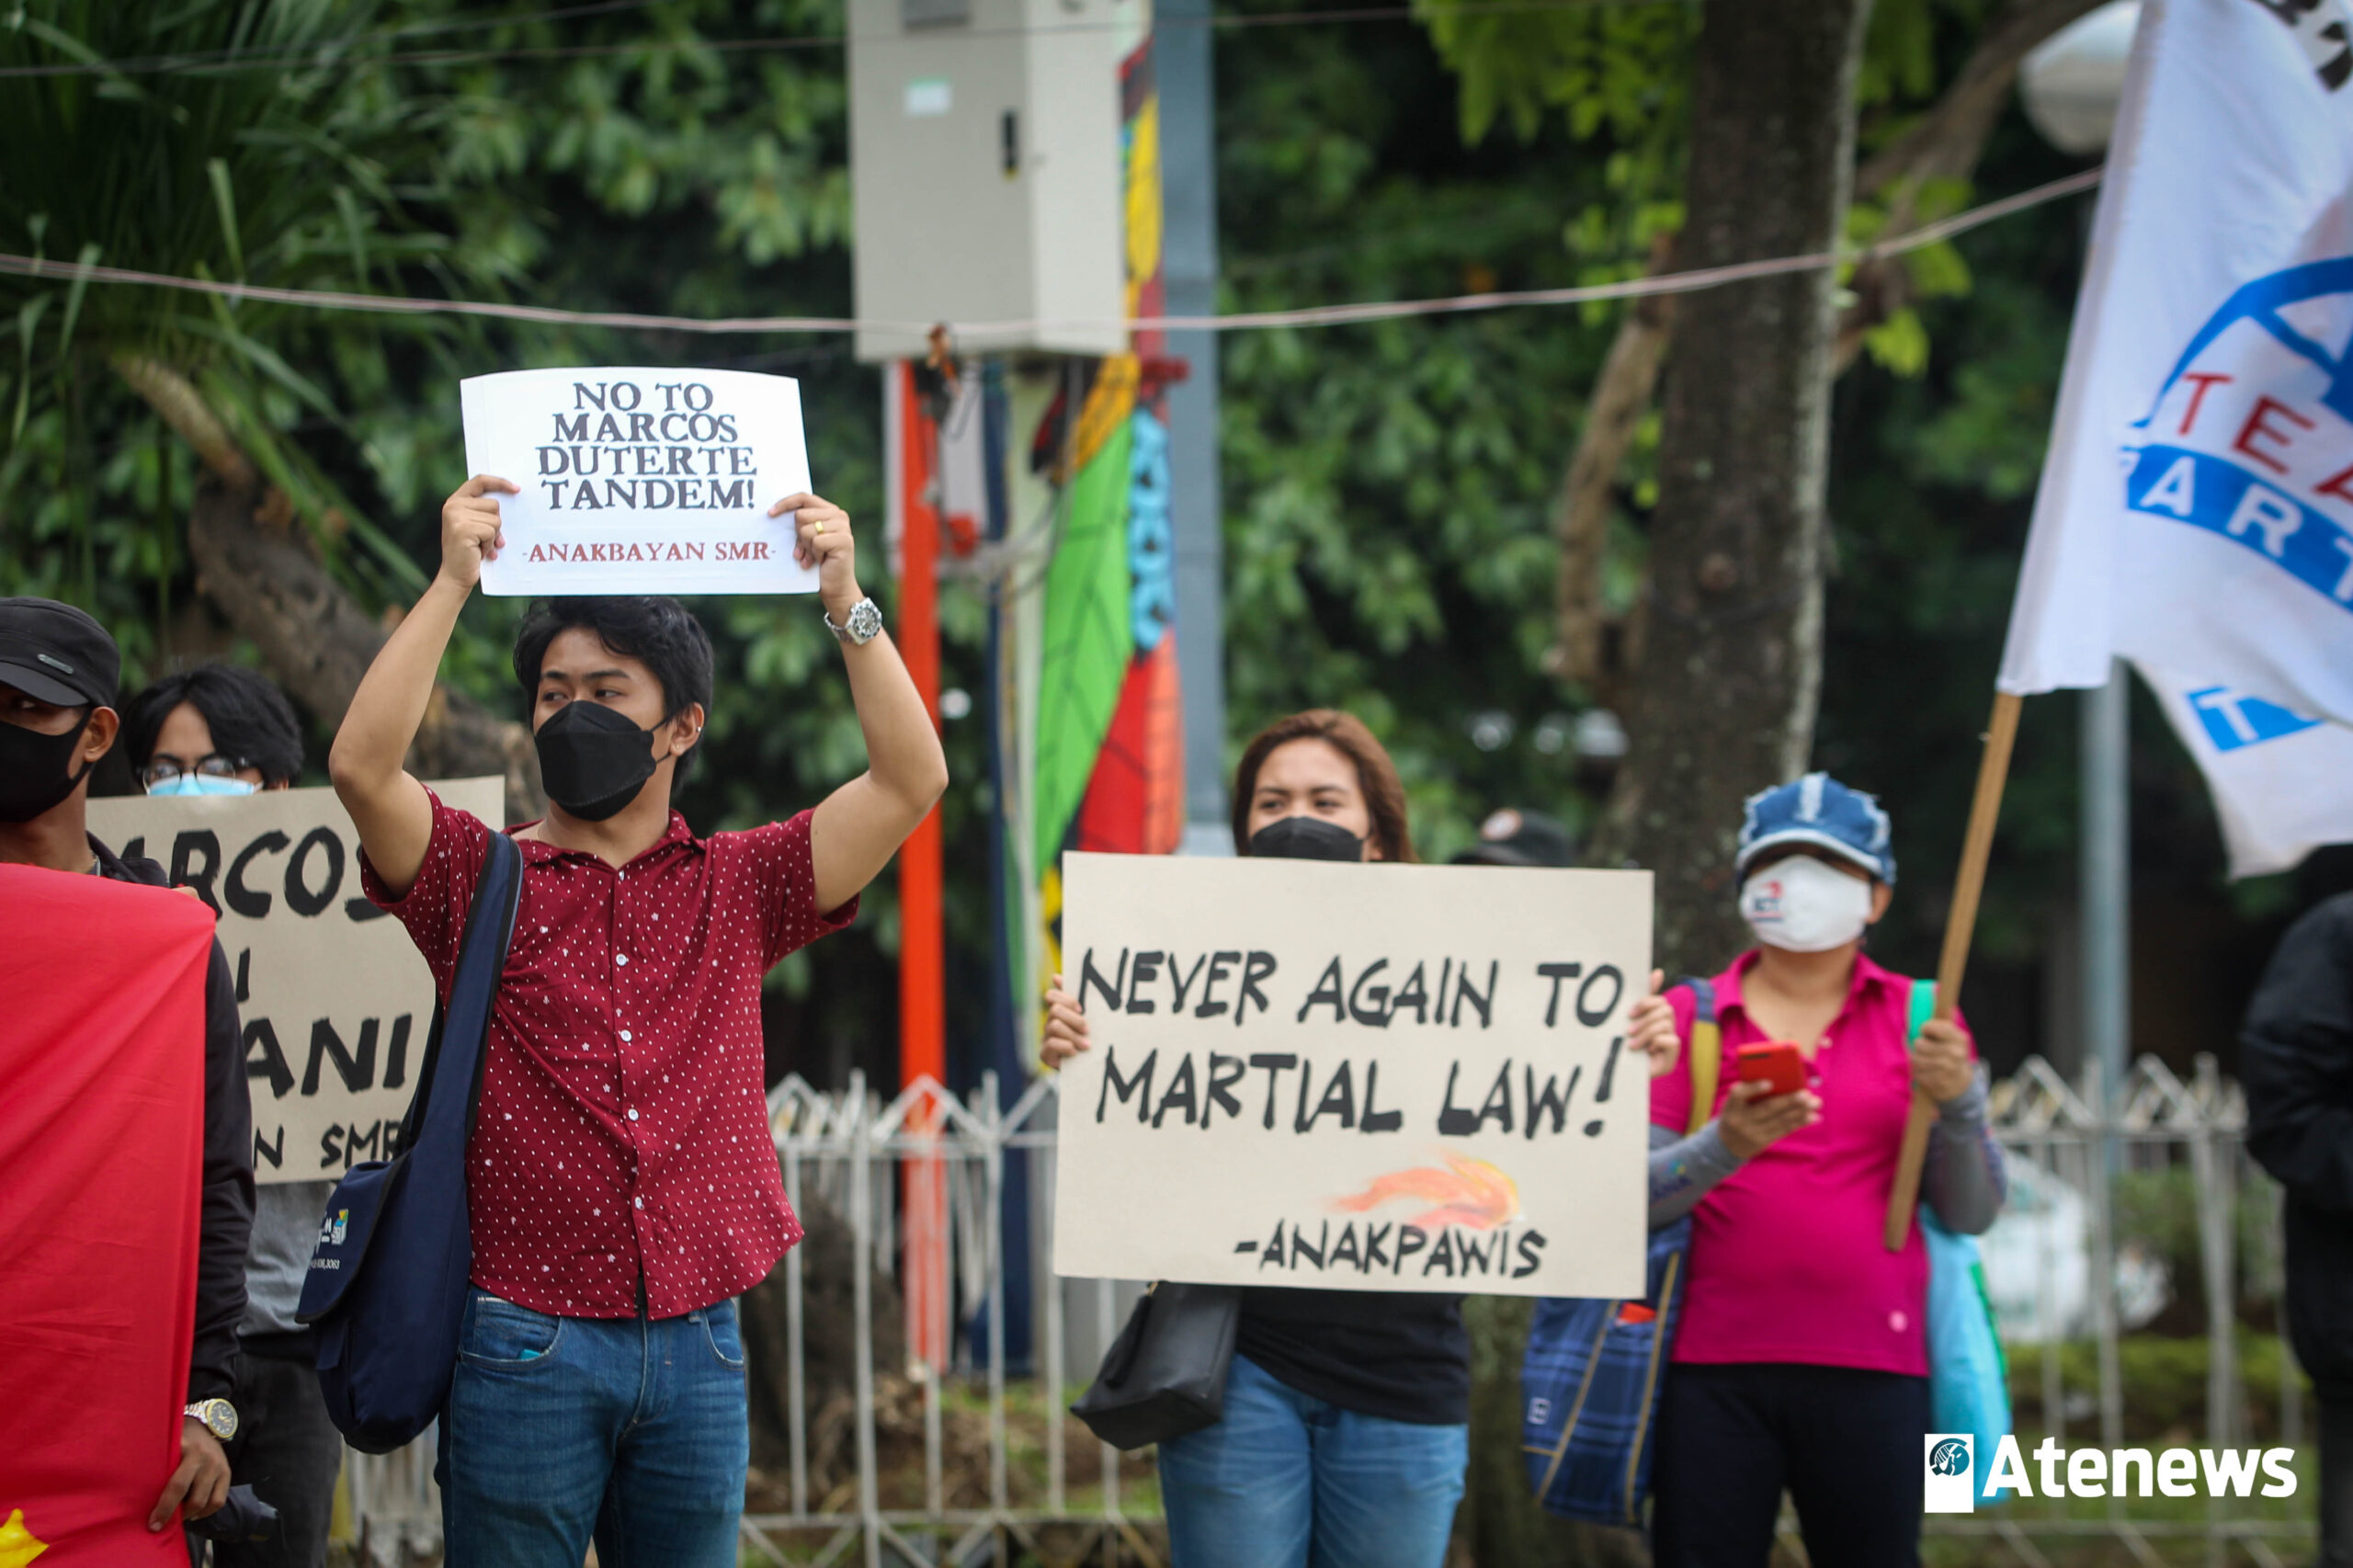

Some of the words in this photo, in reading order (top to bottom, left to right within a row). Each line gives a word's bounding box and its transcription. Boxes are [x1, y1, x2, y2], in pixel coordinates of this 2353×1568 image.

[574, 382, 642, 412] NO
[654, 382, 713, 412] TO
[551, 412, 739, 443] MARCOS
[535, 446, 757, 476] DUTERTE
[540, 478, 756, 510] TANDEM!
[1079, 947, 1278, 1026] NEVER
[1297, 955, 1499, 1028] AGAIN
[1536, 962, 1625, 1028] TO
[1096, 1045, 1403, 1134] MARTIAL
[1438, 1036, 1623, 1140] LAW!
[1233, 1218, 1548, 1278] -ANAKPAWIS
